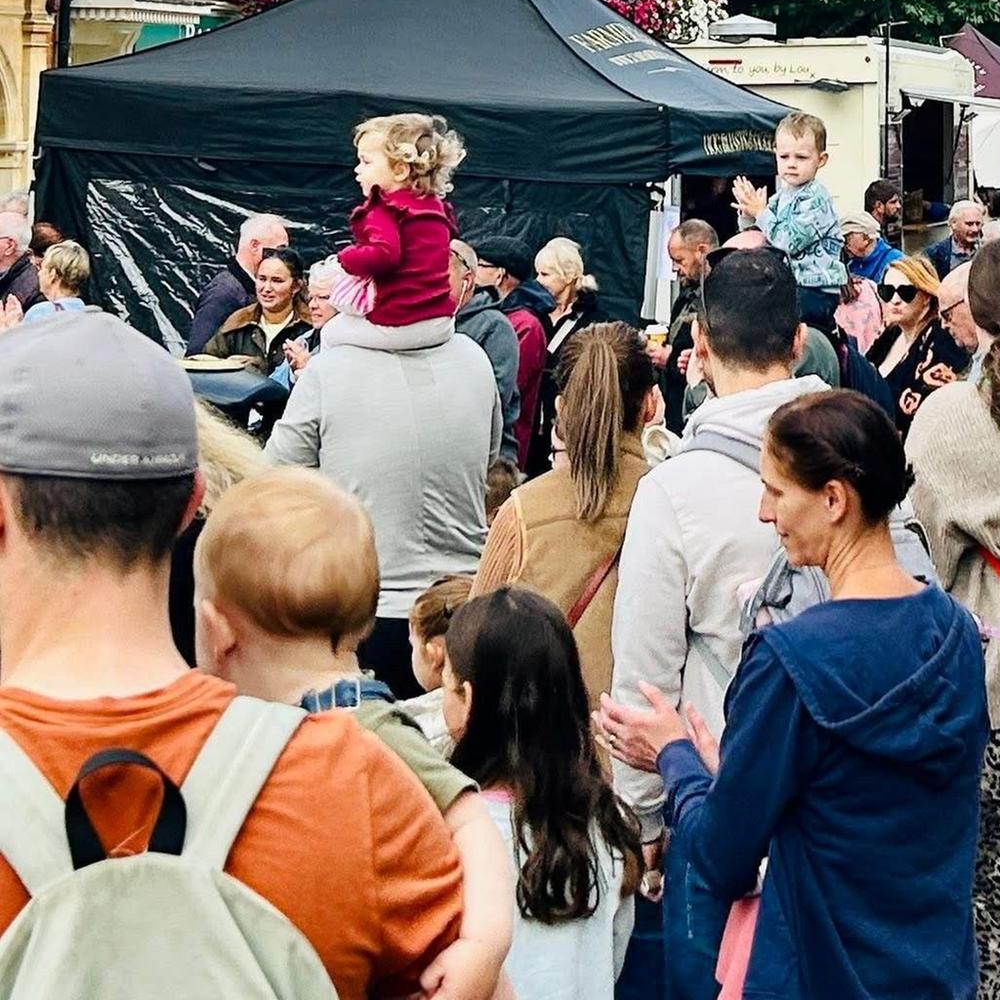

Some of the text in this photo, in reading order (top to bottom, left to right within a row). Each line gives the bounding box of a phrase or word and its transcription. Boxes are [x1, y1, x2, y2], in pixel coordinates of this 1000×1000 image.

[733, 61, 744, 74] to
[749, 65, 769, 77] you
[773, 60, 787, 74] by
[789, 64, 809, 74] Lou
